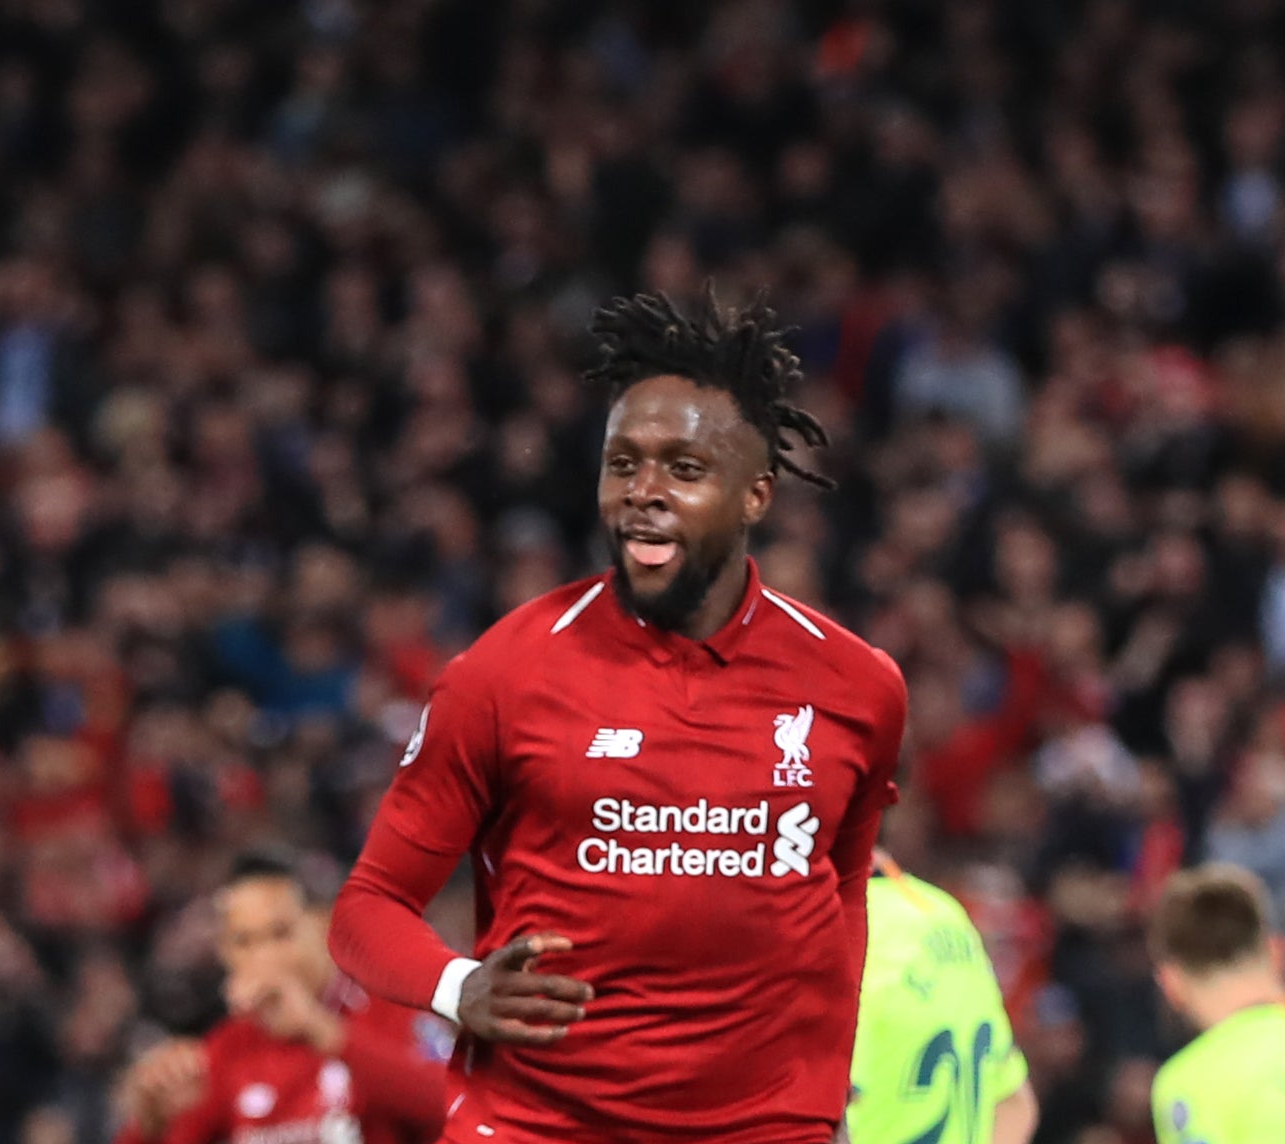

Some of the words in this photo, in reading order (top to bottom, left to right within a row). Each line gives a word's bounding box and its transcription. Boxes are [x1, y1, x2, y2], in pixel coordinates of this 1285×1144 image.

[772, 769, 814, 787] LFC
[592, 797, 769, 834] Standard
[577, 837, 765, 877] Chartered
